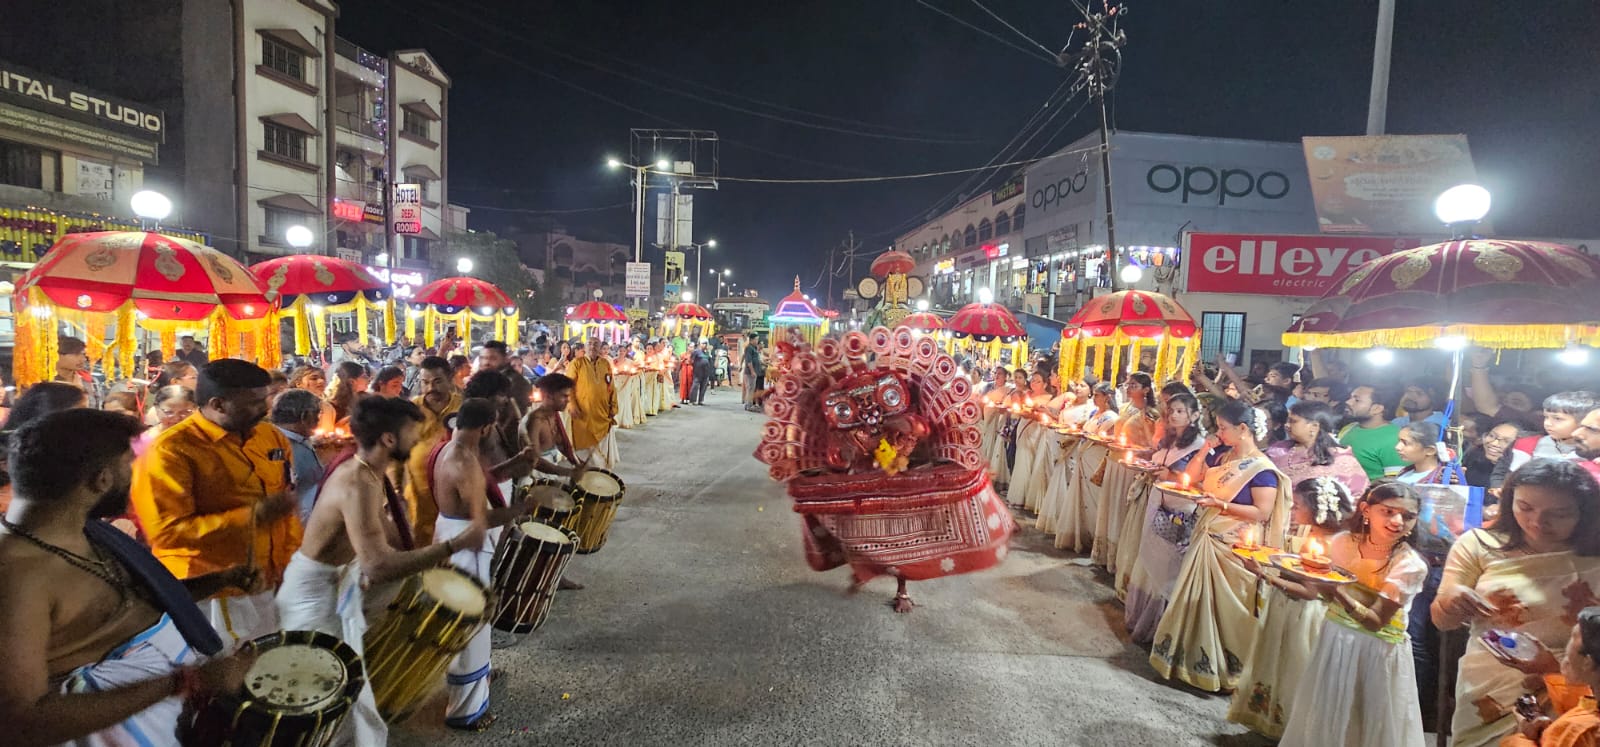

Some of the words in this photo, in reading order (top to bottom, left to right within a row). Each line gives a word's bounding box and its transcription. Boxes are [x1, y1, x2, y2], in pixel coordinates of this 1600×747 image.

[0, 70, 65, 105] ITAL
[70, 91, 161, 132] STUDIO
[395, 187, 418, 204] HOTEL
[396, 222, 419, 233] ROOMS
[1272, 278, 1326, 289] electric
